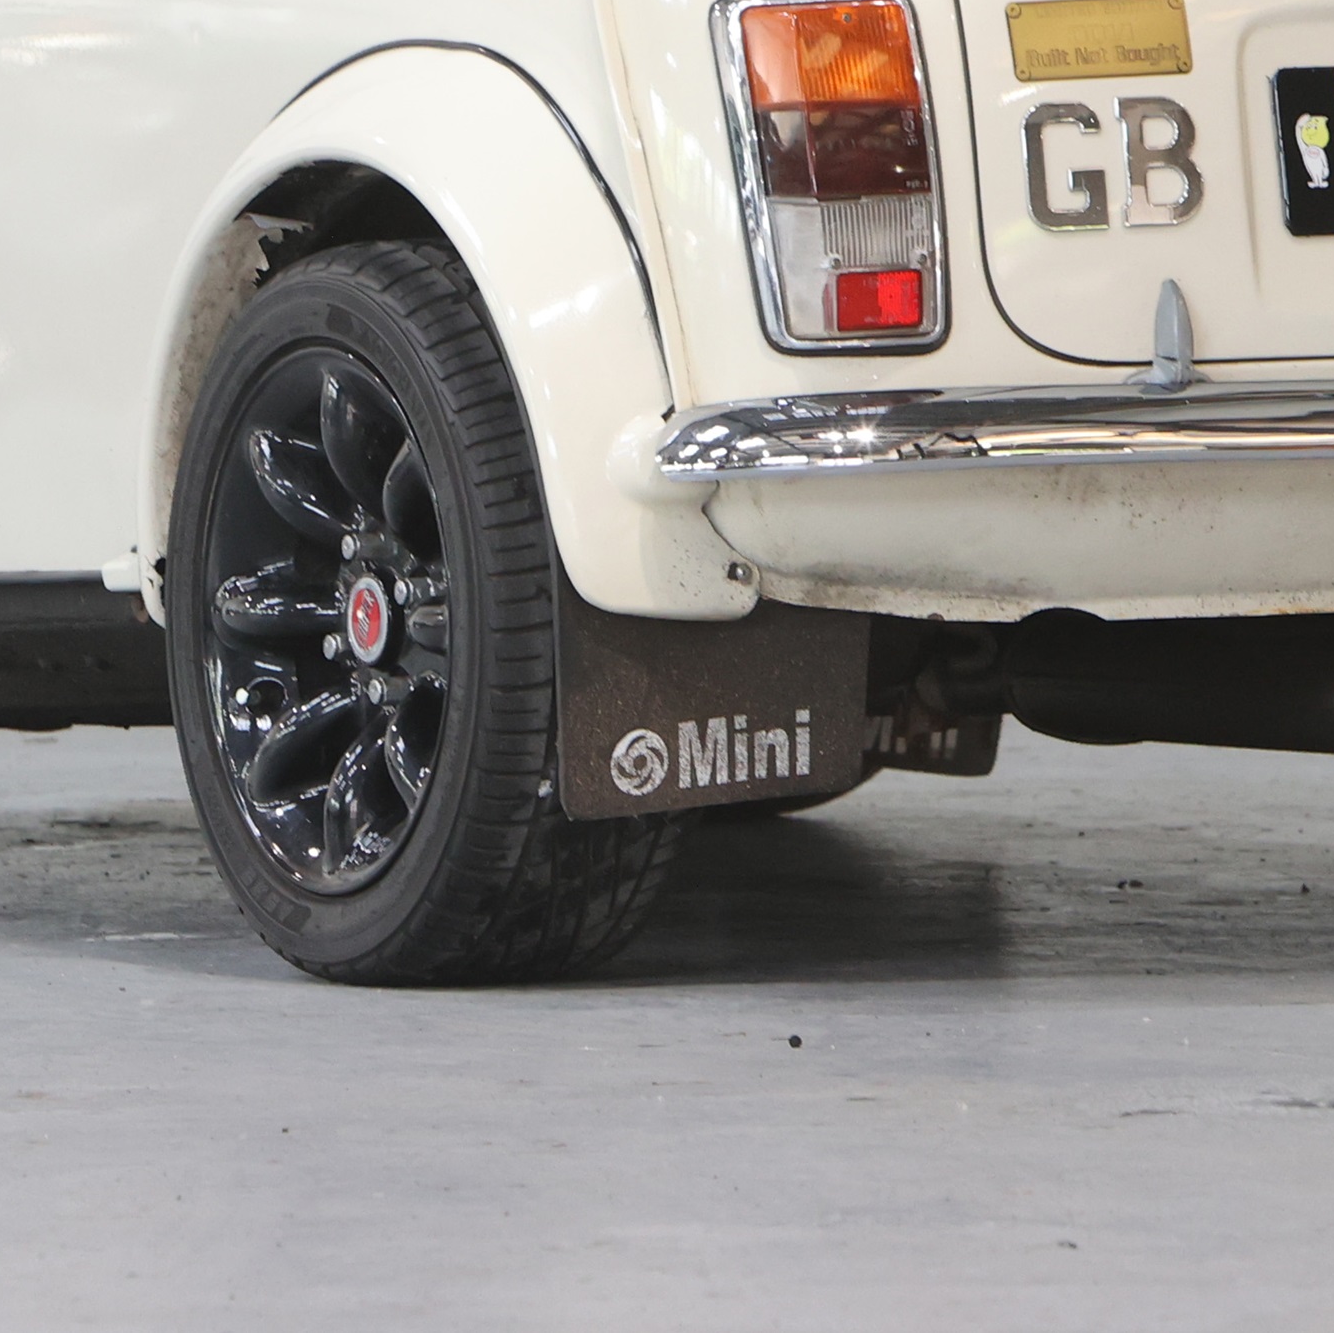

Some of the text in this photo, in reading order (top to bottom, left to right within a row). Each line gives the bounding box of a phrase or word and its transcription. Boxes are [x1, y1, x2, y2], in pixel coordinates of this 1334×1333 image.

[1026, 42, 1182, 69] Built Not Bought
[1020, 96, 1205, 232] GB
[677, 708, 811, 790] Mini
